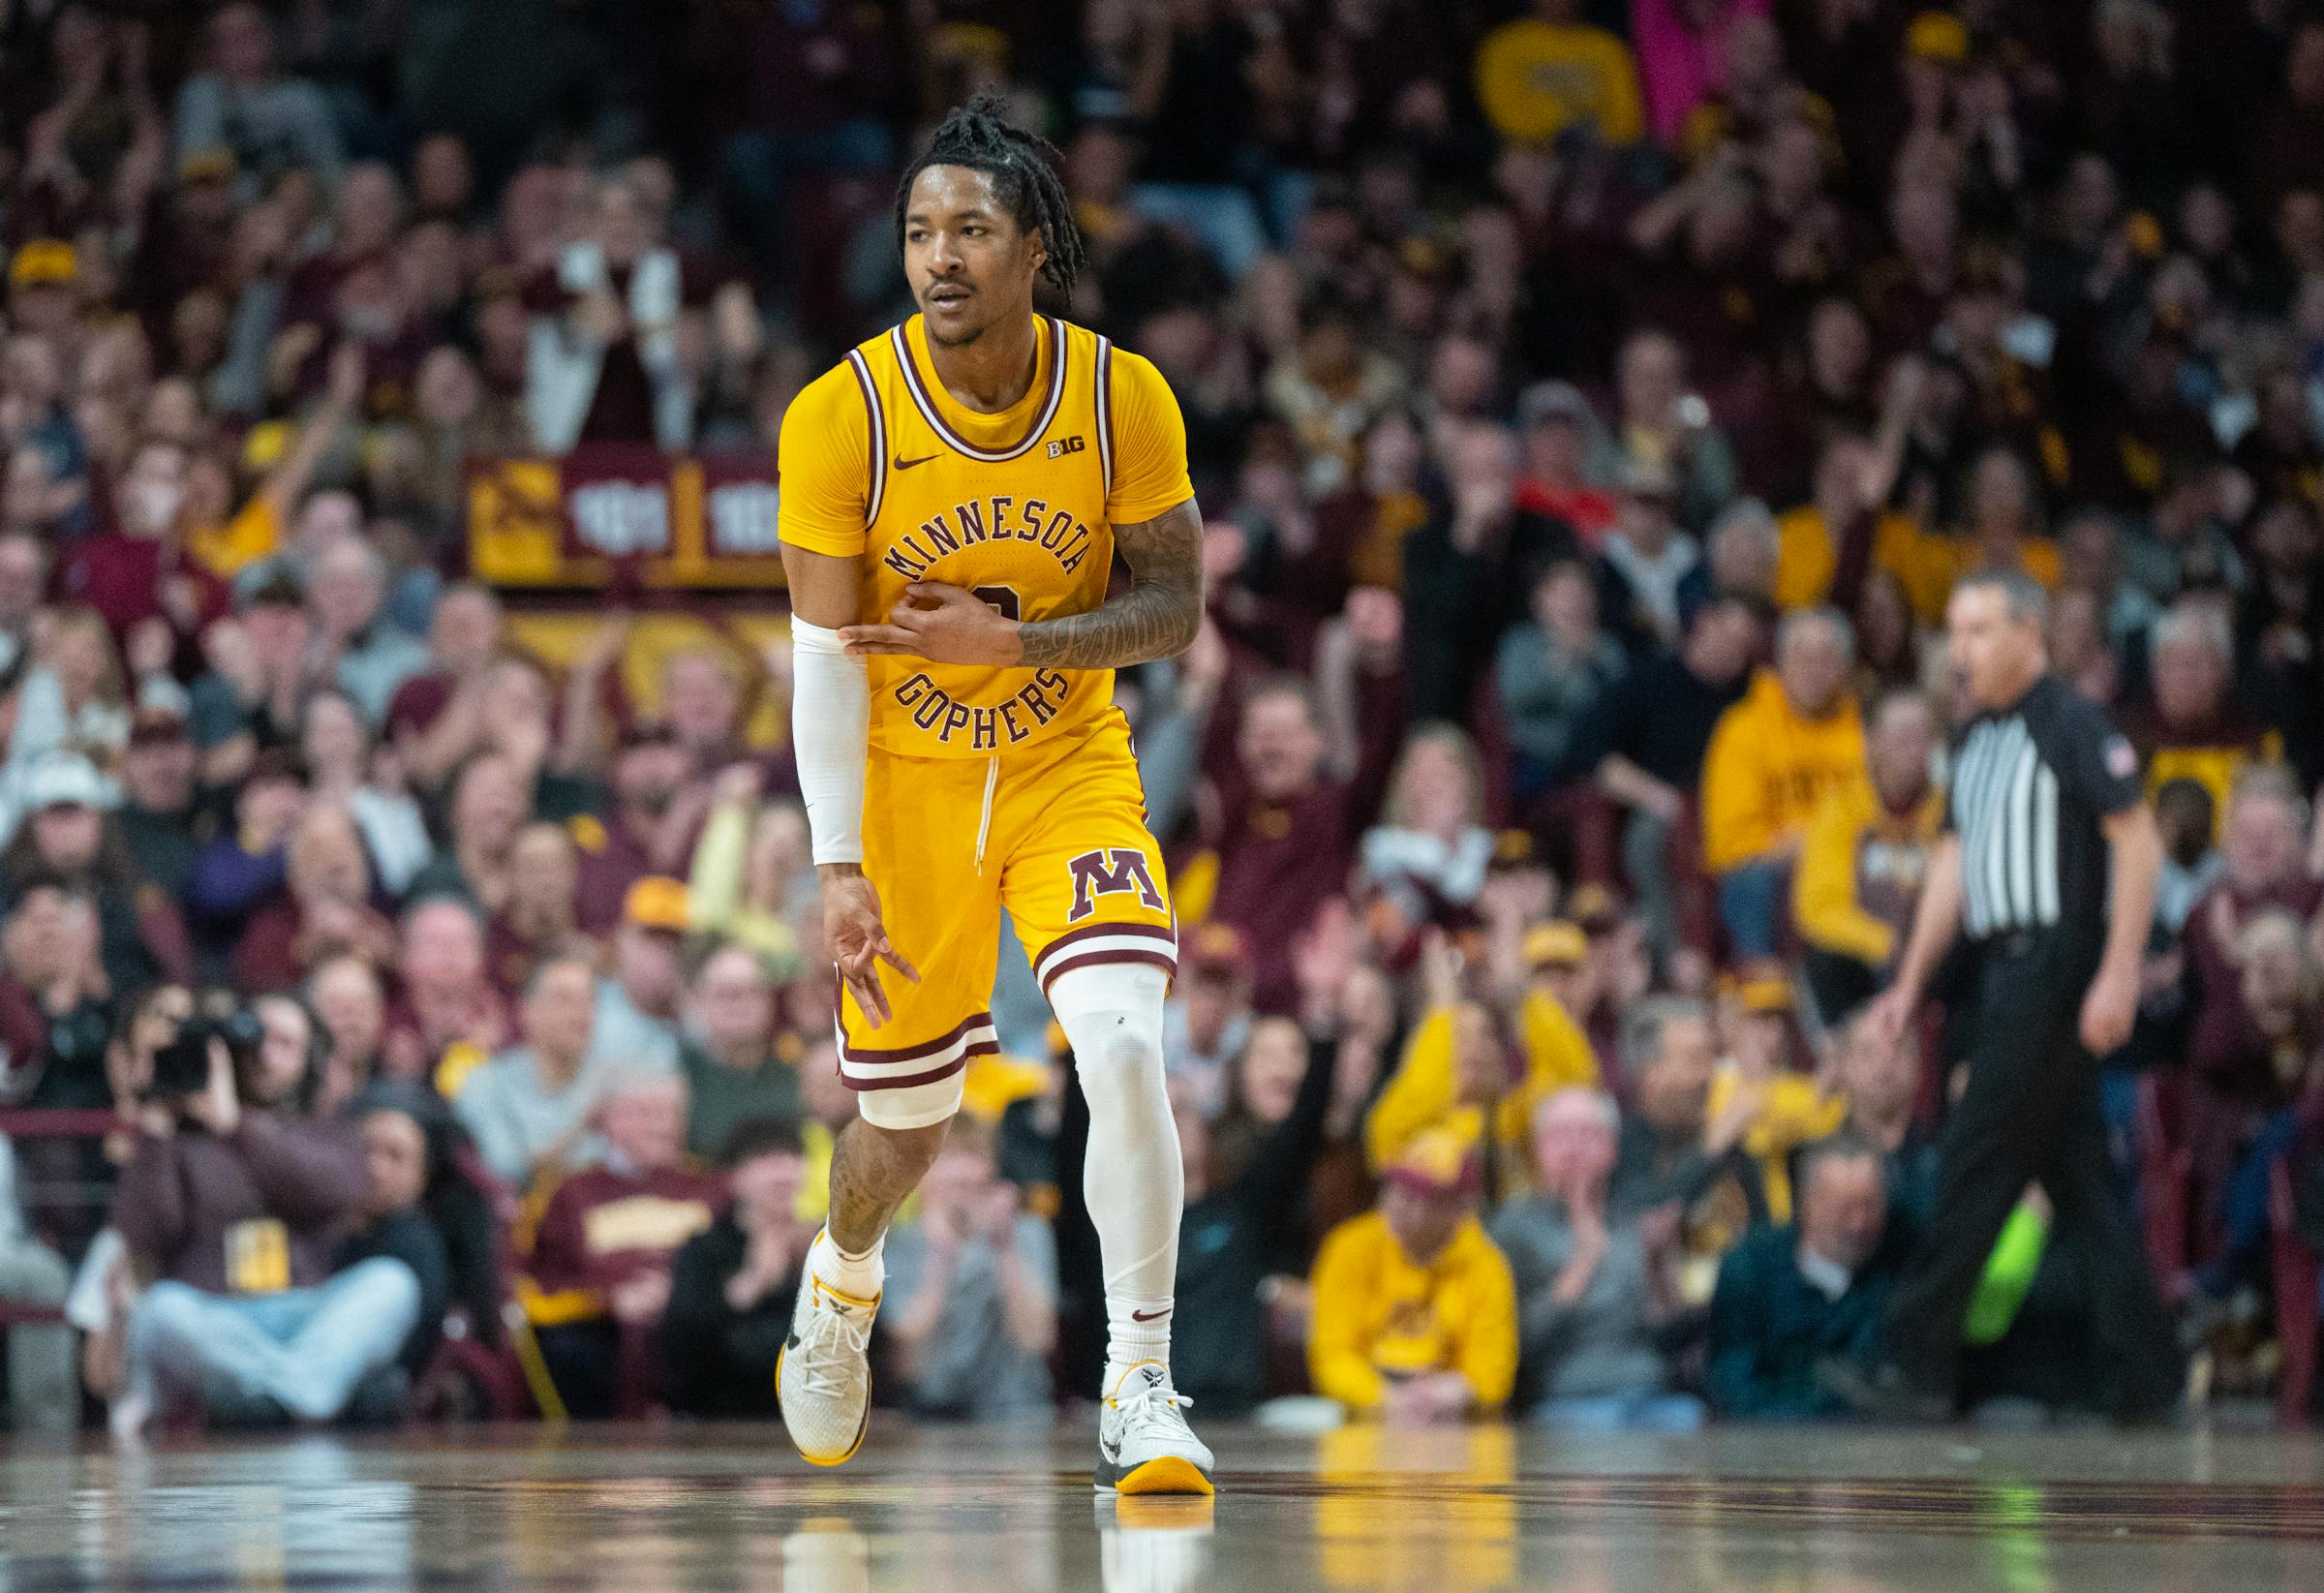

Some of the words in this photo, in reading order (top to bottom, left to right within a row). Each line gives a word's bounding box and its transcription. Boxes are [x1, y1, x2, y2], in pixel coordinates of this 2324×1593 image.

[881, 495, 1091, 581] MINNESOTA
[894, 666, 1069, 750] GOPHERS
[1067, 848, 1167, 925] M
